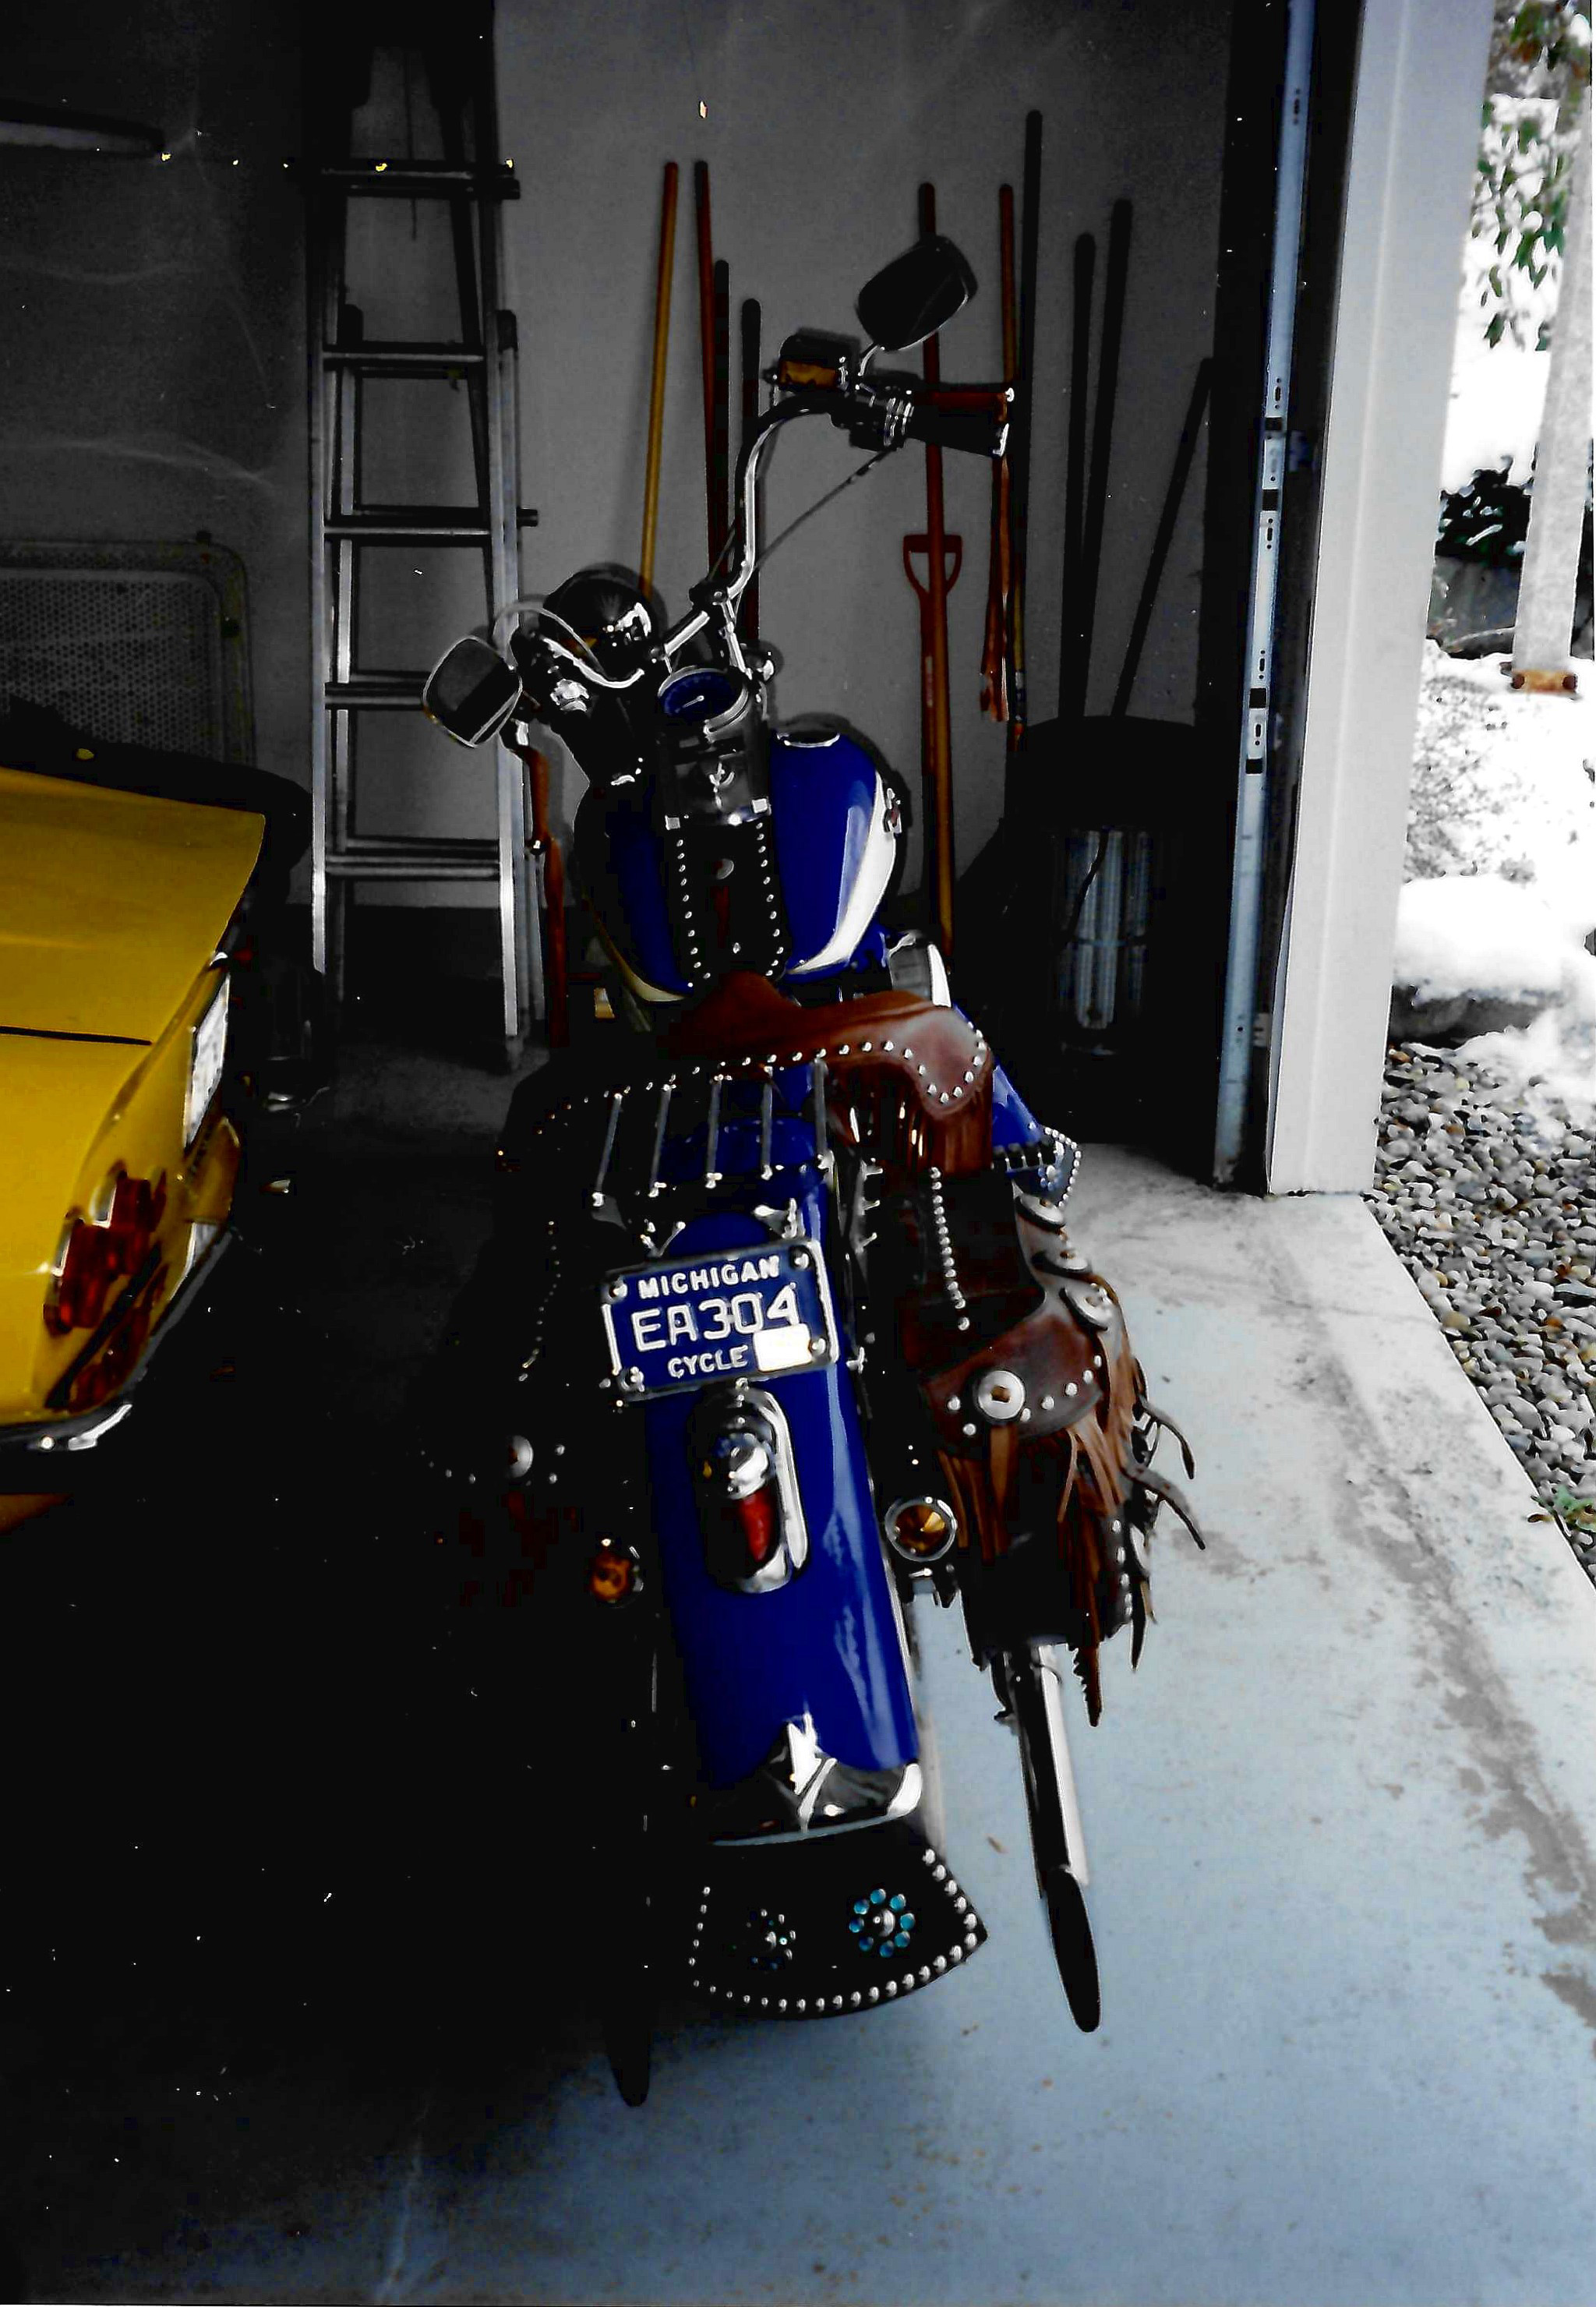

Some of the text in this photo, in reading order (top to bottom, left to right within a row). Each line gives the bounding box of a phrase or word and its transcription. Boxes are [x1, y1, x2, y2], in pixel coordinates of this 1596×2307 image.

[637, 1255, 780, 1299] MICHIGAN
[630, 1282, 800, 1352] EA304
[667, 1344, 748, 1379] CYCLE
